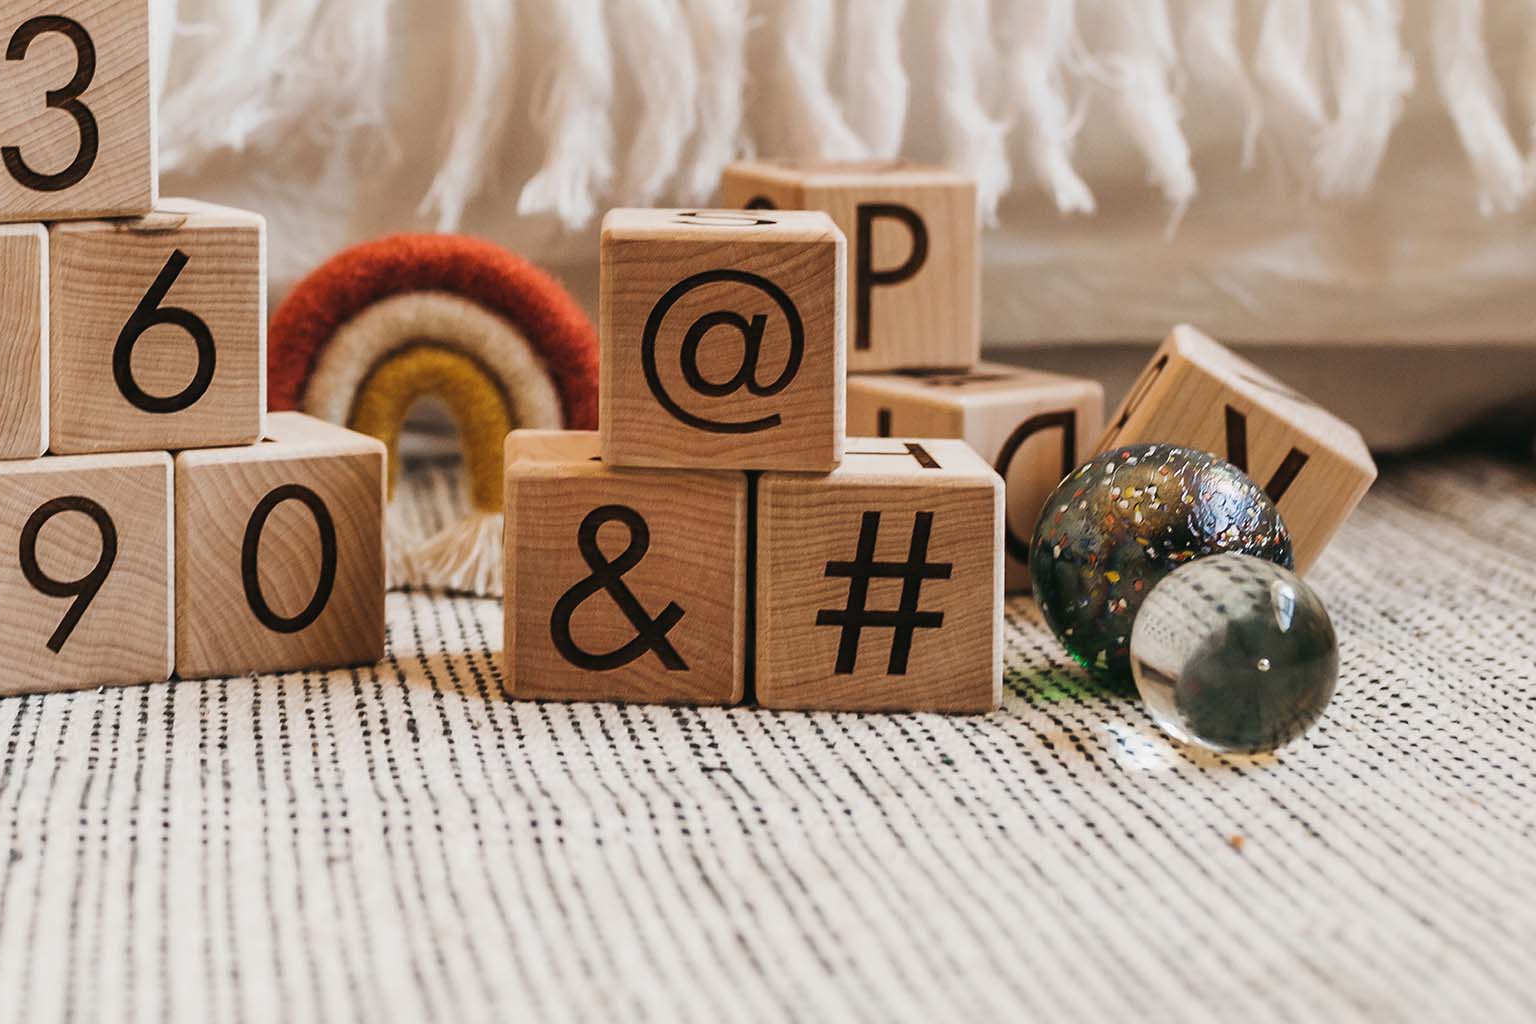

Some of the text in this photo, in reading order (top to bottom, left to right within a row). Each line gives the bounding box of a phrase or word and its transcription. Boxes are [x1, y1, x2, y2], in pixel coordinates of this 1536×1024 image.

[1, 15, 99, 192] 3
[113, 249, 216, 413] 6
[641, 269, 804, 433] @
[855, 203, 928, 350] P
[19, 496, 118, 654] 9
[550, 505, 689, 671] &
[816, 511, 952, 675] #
